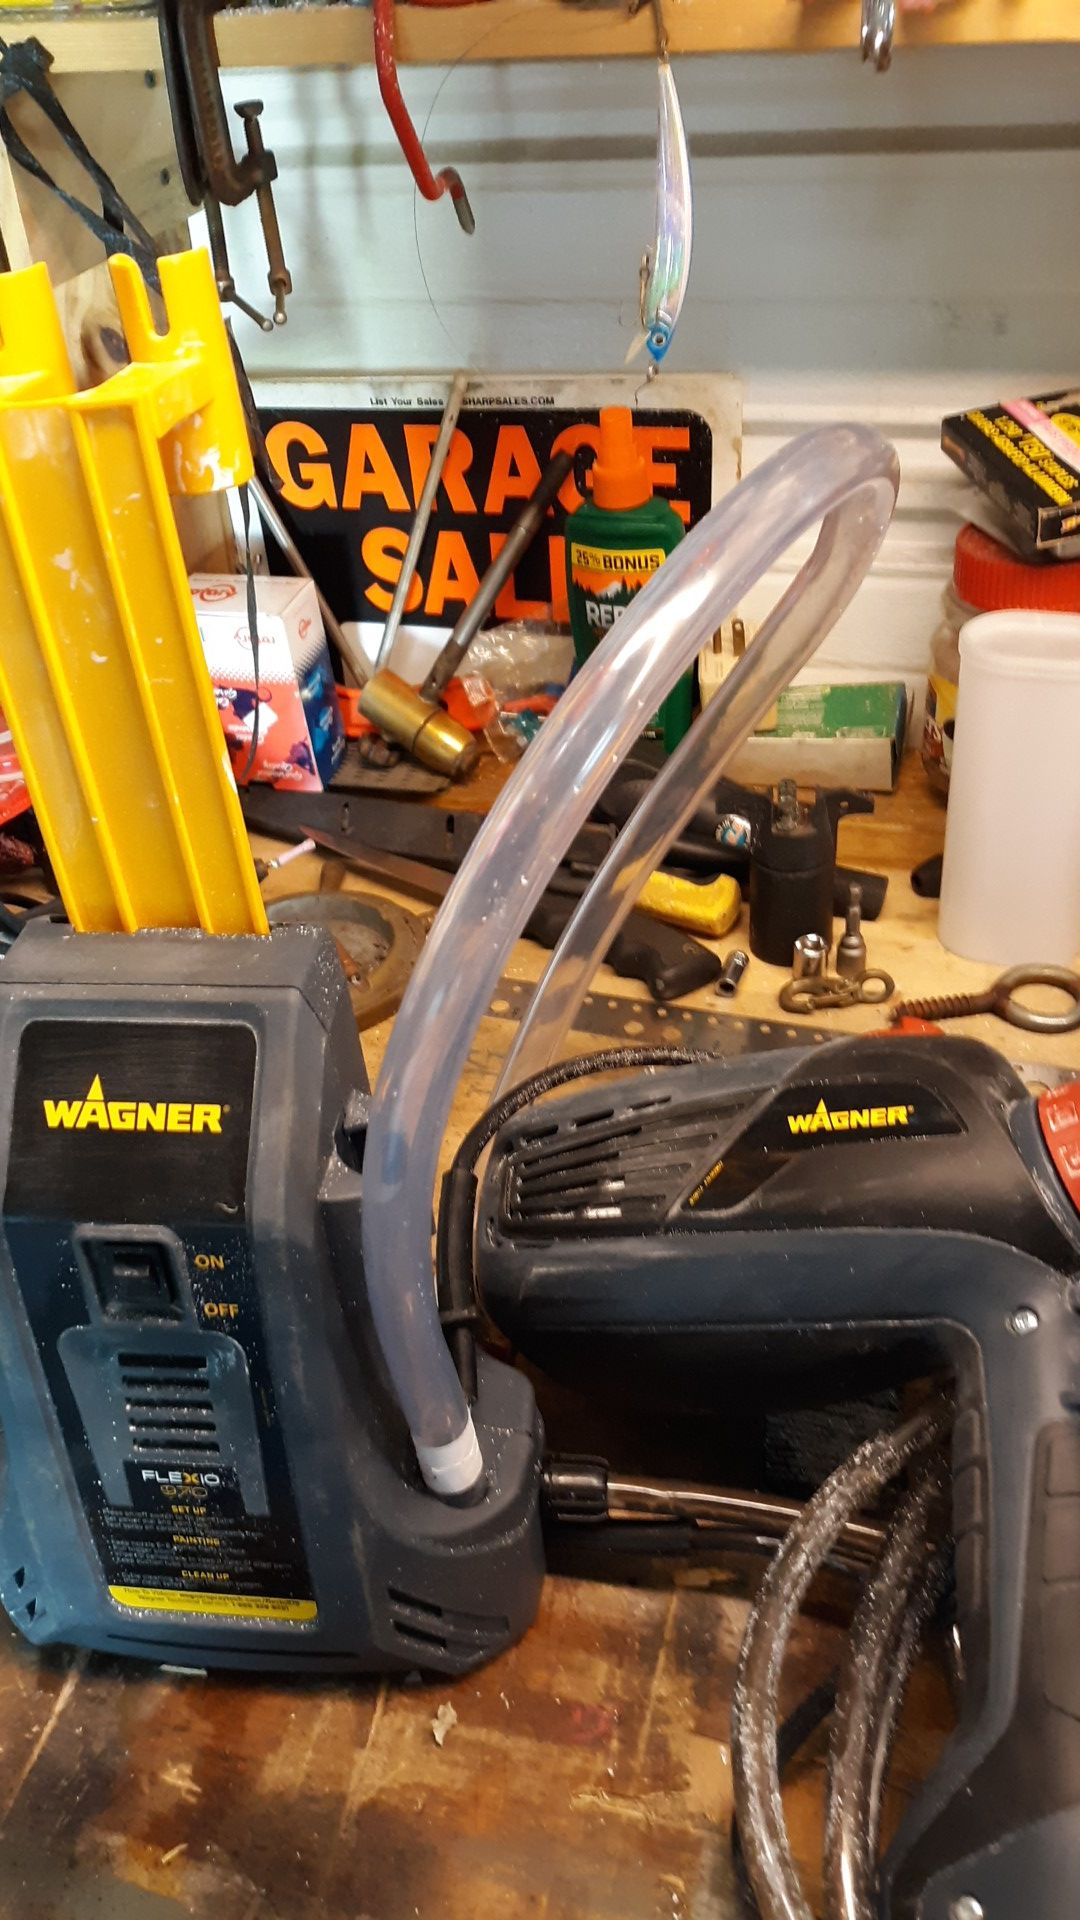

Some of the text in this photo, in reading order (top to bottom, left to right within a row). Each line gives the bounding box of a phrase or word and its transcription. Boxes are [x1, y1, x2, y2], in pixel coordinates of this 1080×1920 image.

[370, 397, 387, 406] List
[391, 397, 412, 406] Your
[416, 397, 444, 406] Sales
[602, 555, 660, 570] BONUS
[585, 600, 628, 630] REP
[43, 1073, 223, 1134] WAGNER
[787, 1097, 909, 1135] WAGNER
[194, 1254, 225, 1271] ON
[203, 1302, 239, 1319] OFF
[141, 1469, 221, 1487] FLEXIO
[160, 1484, 208, 1499] 970
[171, 1504, 207, 1517] SET UP
[172, 1534, 221, 1549] PAINTING
[181, 1569, 215, 1580] CLEAN
[216, 1572, 230, 1581] UP
